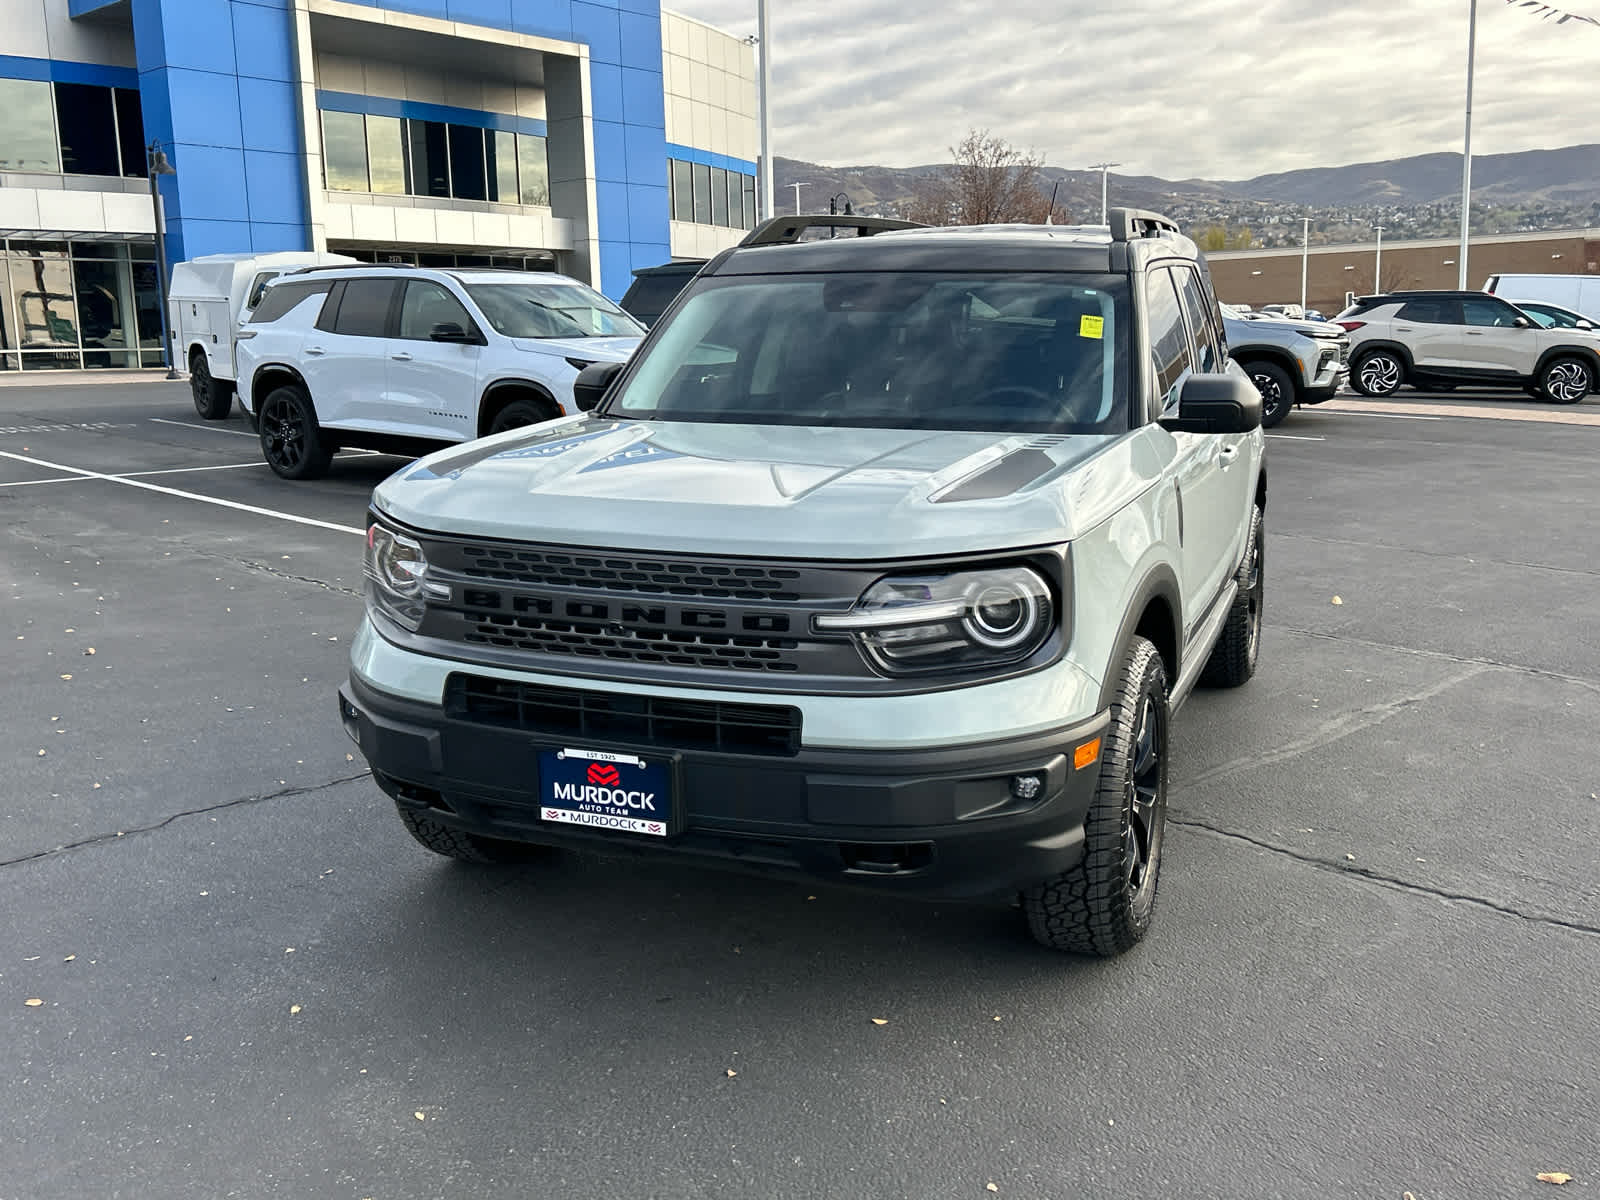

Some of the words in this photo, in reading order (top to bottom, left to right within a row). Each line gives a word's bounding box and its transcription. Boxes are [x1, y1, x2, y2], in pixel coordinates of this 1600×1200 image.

[464, 590, 790, 631] BRONCO
[553, 782, 655, 811] MURDOCK
[570, 812, 637, 830] MURDOCK
[579, 803, 602, 812] AUTO
[606, 807, 628, 816] TEAM
